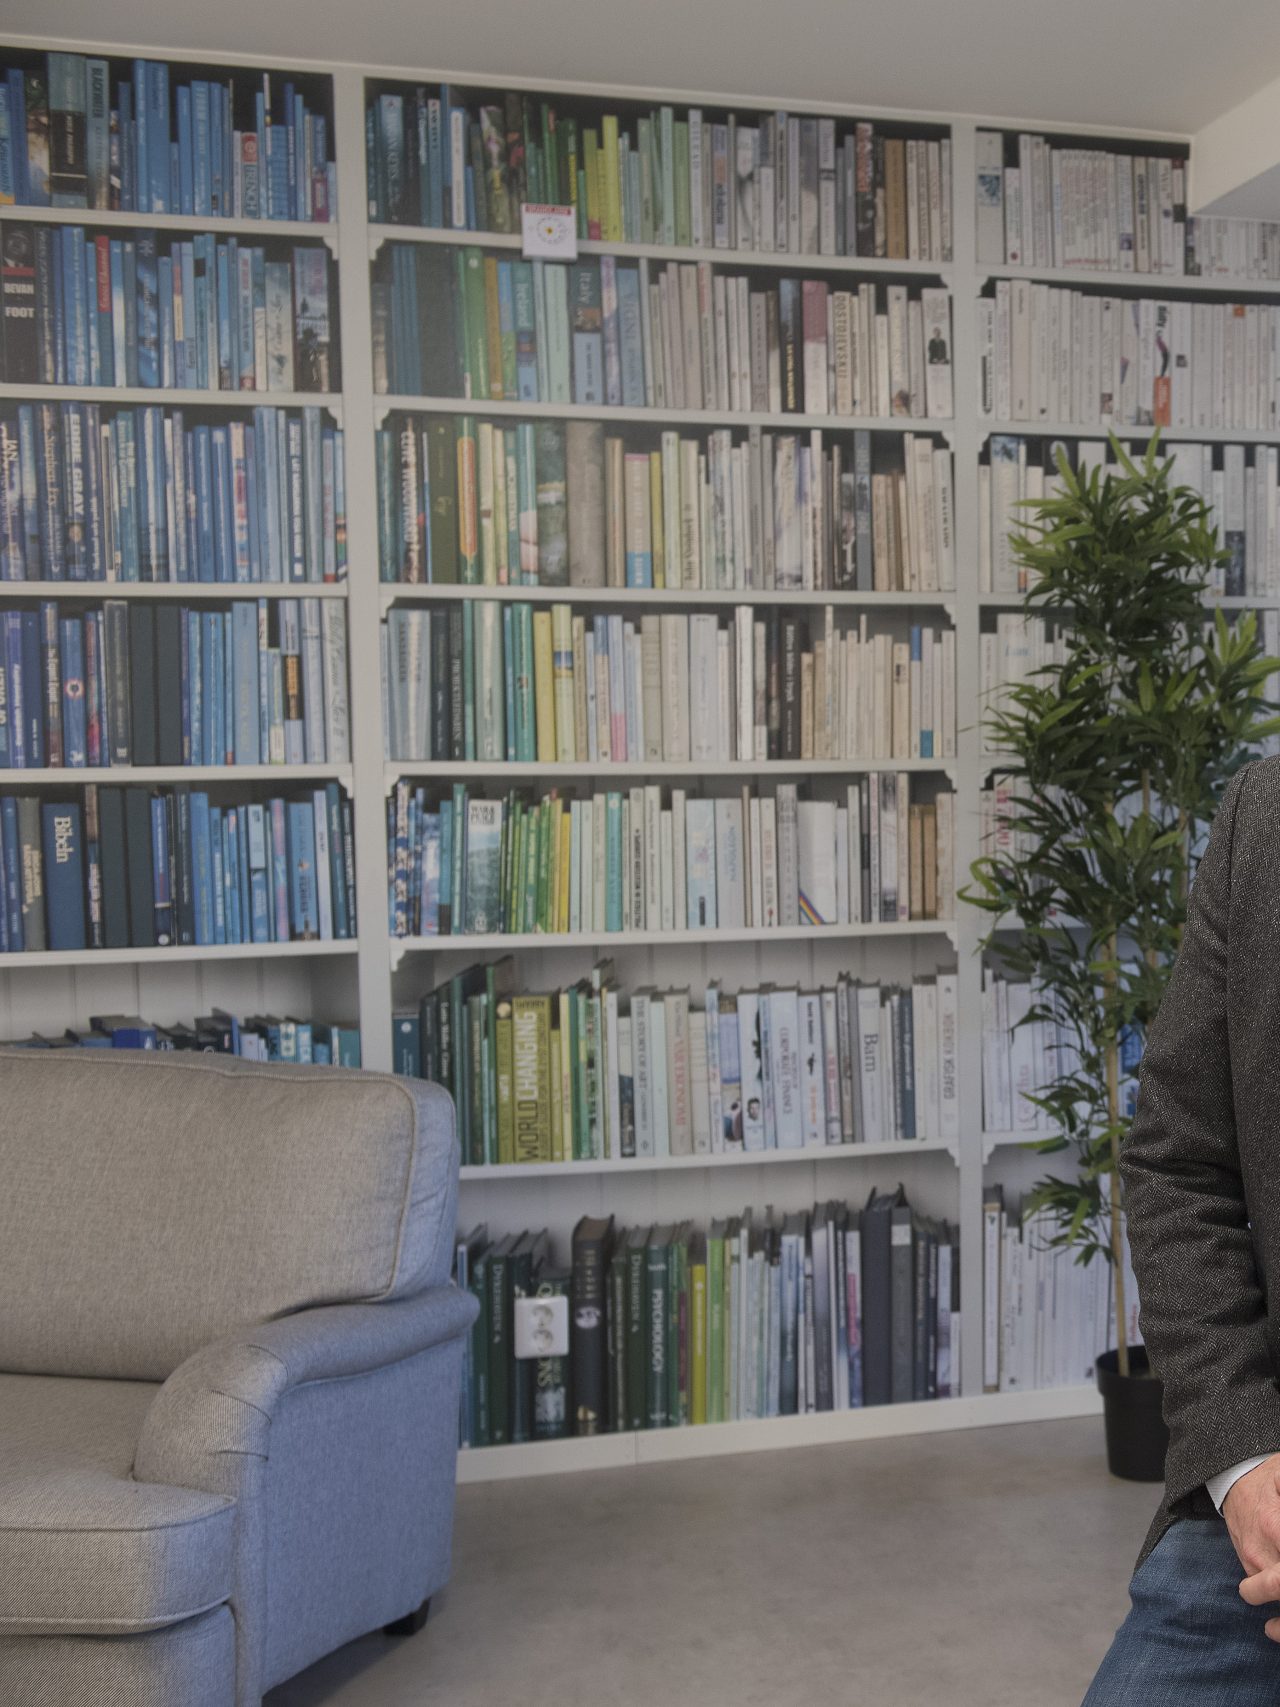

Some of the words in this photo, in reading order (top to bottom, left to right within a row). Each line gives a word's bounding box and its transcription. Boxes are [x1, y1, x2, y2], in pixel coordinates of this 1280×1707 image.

[4, 282, 34, 294] BEVAN
[516, 283, 531, 328] Ireland
[578, 271, 594, 305] Italy
[5, 306, 35, 318] FOOT
[70, 413, 82, 463] EDDIE
[45, 435, 57, 482] Stephen
[47, 487, 59, 507] Fry
[72, 467, 84, 516] GRAY
[639, 1070, 649, 1090] ART
[650, 1287, 664, 1375] PSYCHOLOGY
